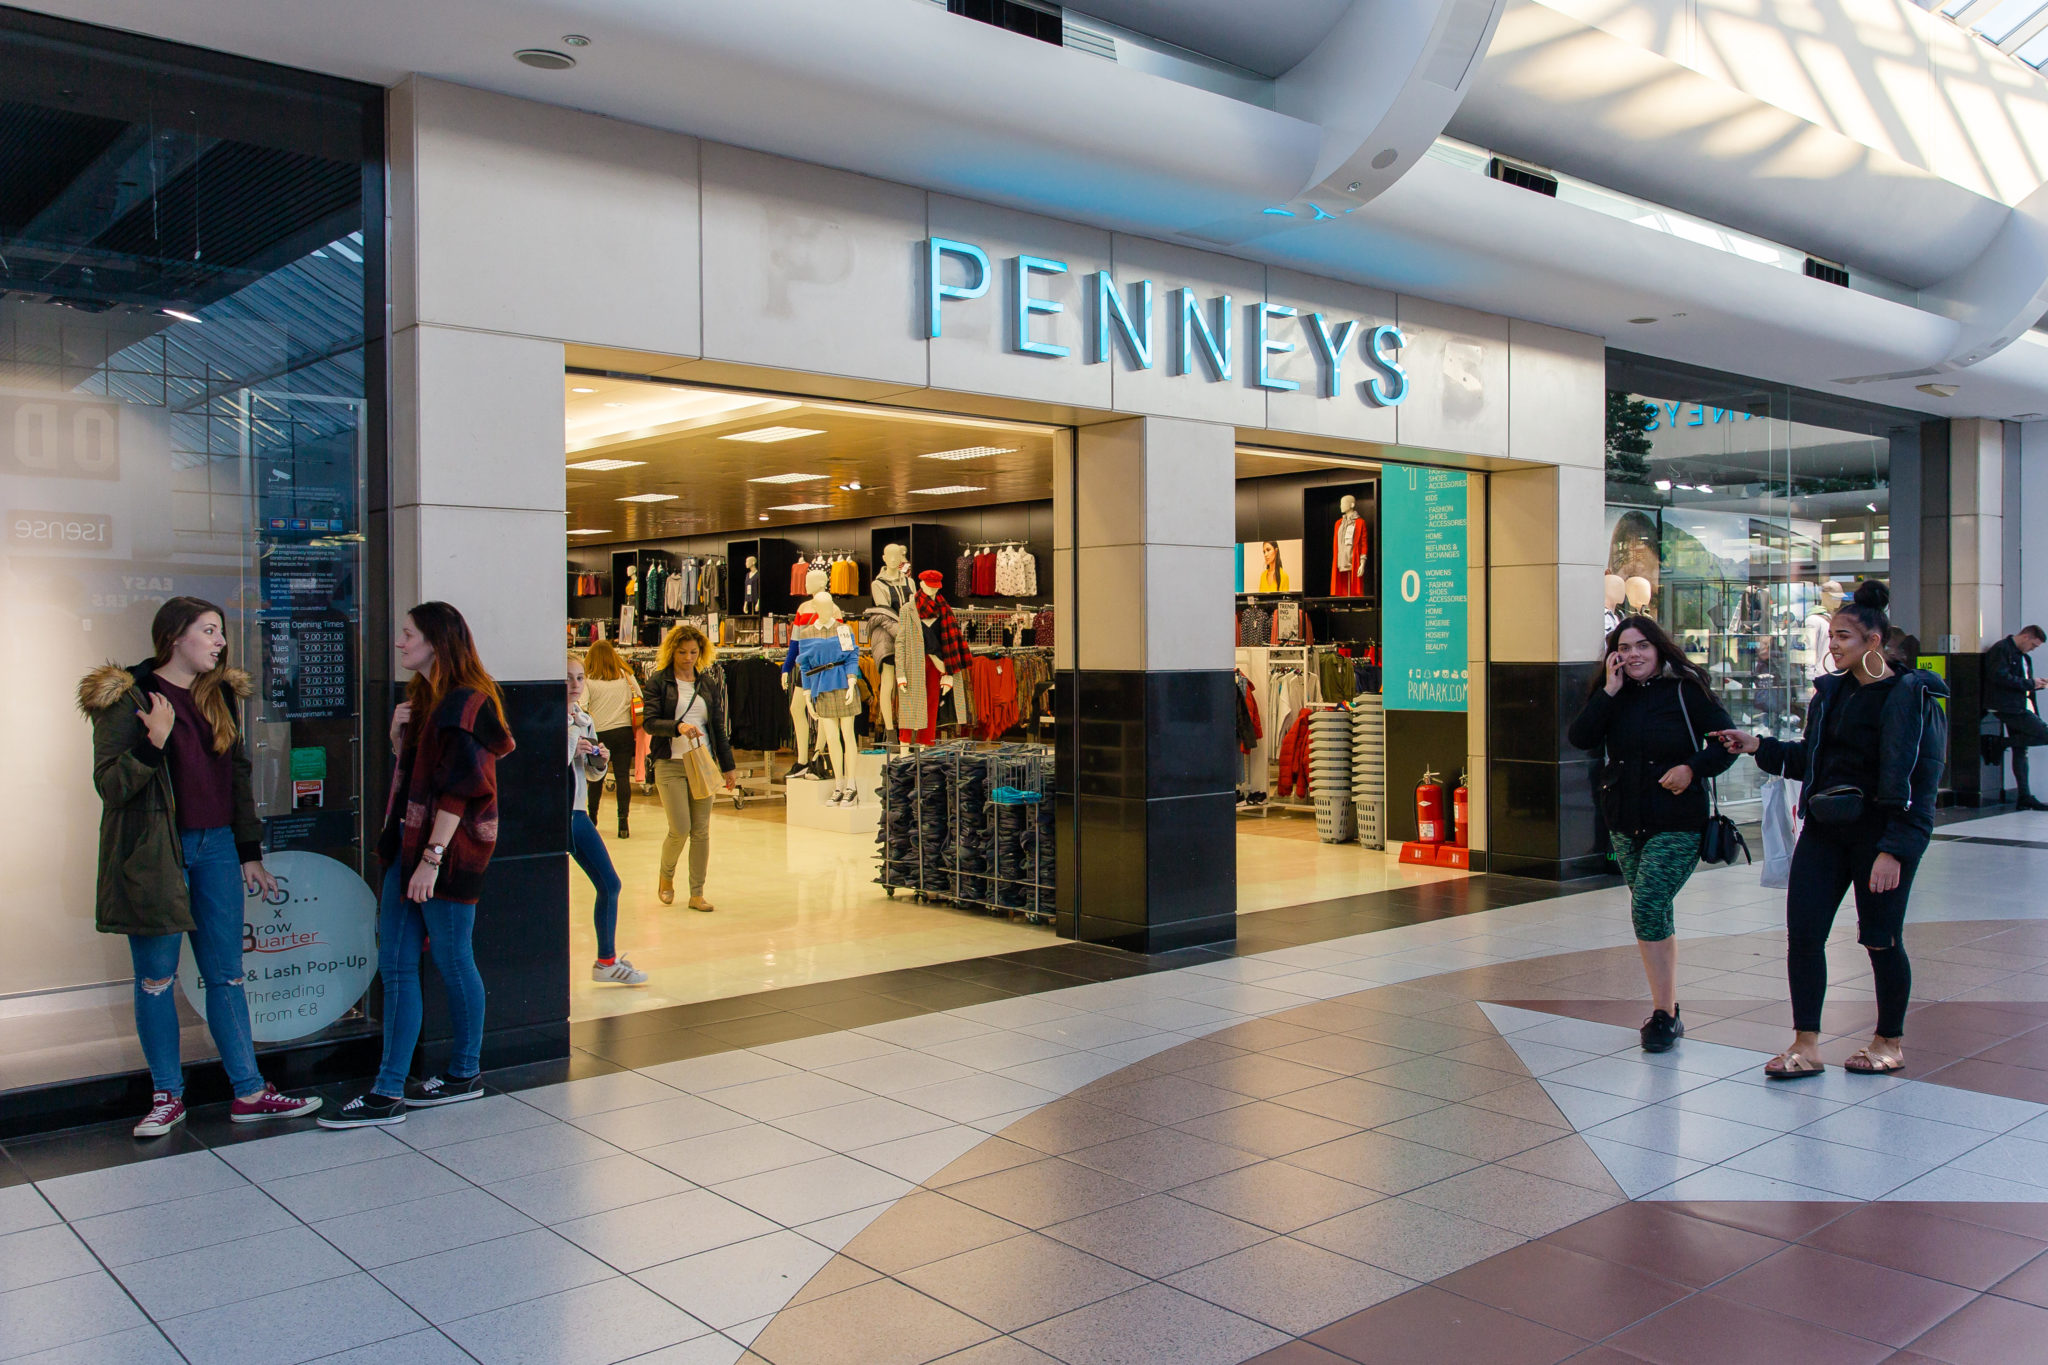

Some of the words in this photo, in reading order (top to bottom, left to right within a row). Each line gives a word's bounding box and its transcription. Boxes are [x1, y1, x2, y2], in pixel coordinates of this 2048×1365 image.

[926, 237, 1409, 407] PENNEYS
[1428, 480, 1466, 489] ACCESSORIES
[1428, 519, 1466, 527] ACCESSORIES
[1401, 570, 1420, 602] 0
[1408, 680, 1468, 702] PRIMARK.COM
[247, 970, 258, 981] &
[264, 964, 301, 980] Lash
[308, 955, 367, 973] Pop-Up
[246, 984, 325, 1005] Threading
[255, 1008, 292, 1024] from
[298, 1003, 318, 1016] €8
